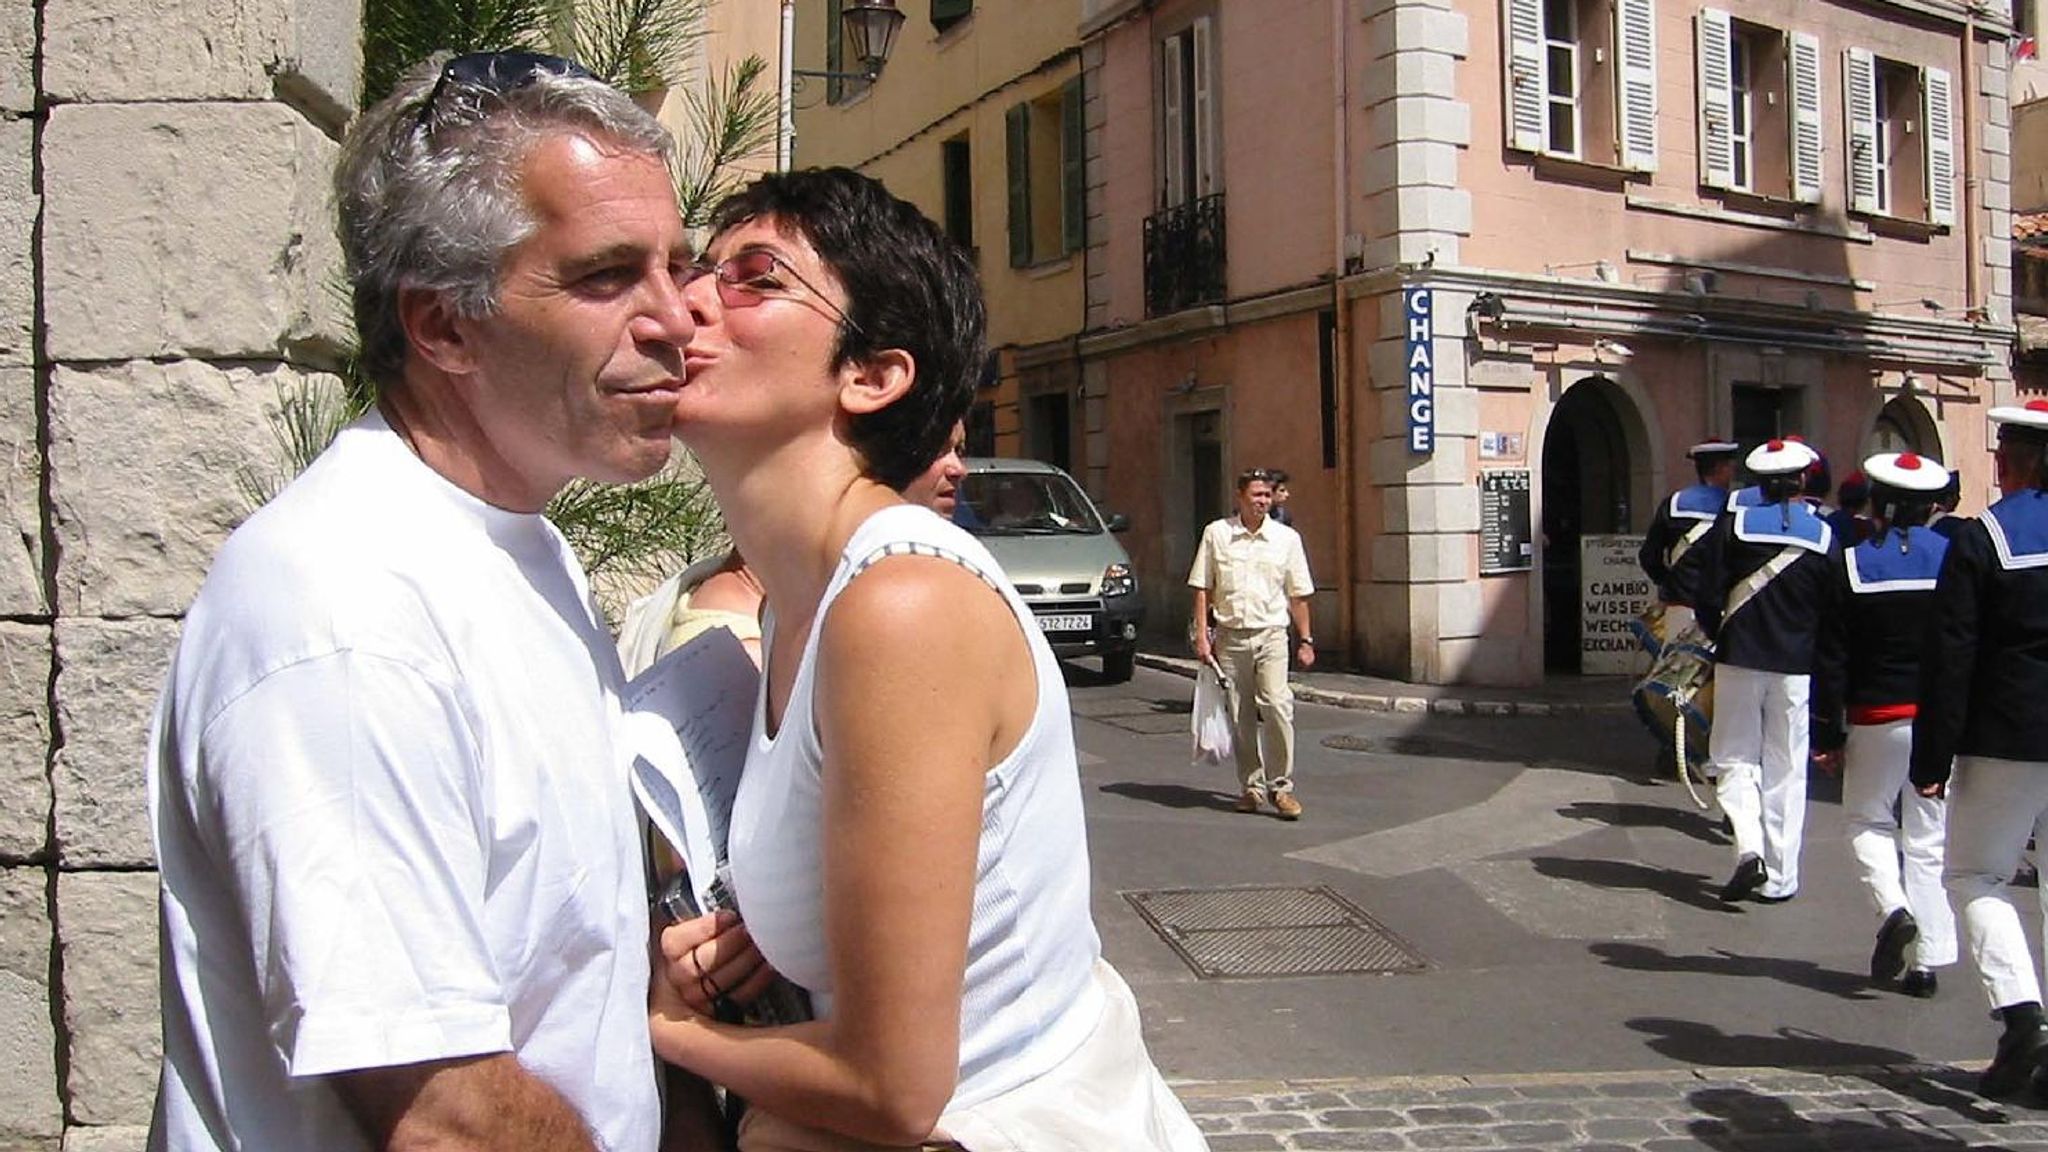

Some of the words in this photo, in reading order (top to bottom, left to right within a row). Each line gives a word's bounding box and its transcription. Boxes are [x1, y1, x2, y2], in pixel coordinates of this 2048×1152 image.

[1409, 290, 1431, 450] CHANGE
[1590, 582, 1649, 596] CAMBIO
[1585, 601, 1648, 615] WISSE
